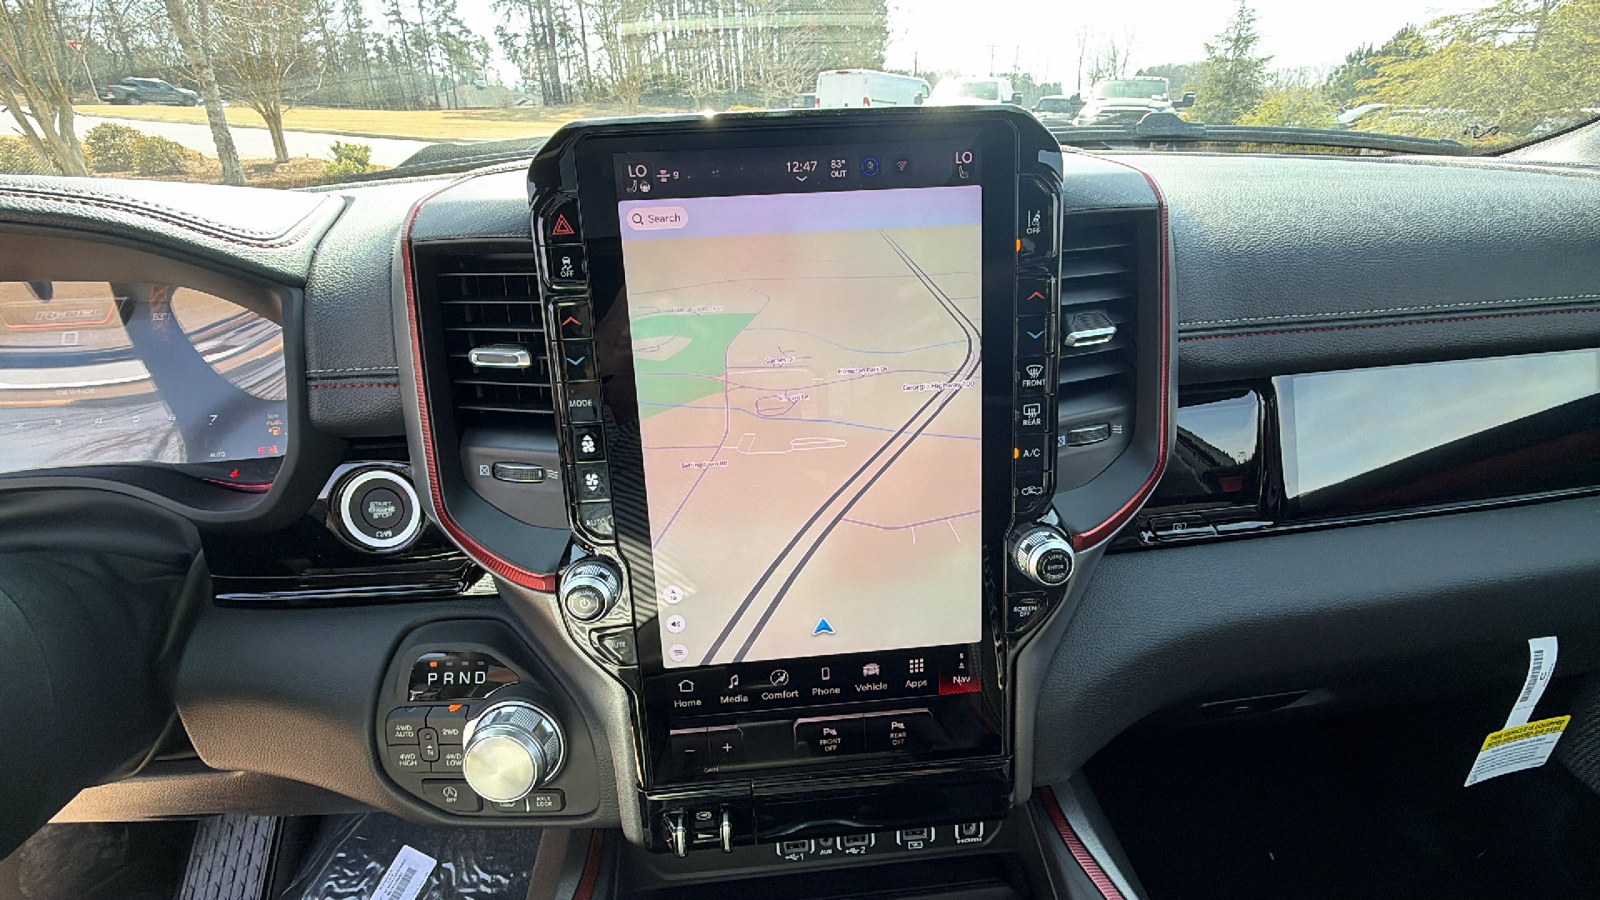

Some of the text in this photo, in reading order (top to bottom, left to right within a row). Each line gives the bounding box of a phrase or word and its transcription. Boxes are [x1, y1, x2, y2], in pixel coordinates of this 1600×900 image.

[955, 151, 972, 164] LO
[628, 164, 647, 178] LO
[786, 160, 818, 173] 12:47
[830, 169, 847, 178] OUT
[648, 213, 681, 224] Search
[1026, 227, 1041, 235] OFF
[560, 270, 575, 278] OFF
[866, 366, 880, 374] Park
[902, 384, 930, 393] Georgia
[931, 381, 961, 391] Highway
[1022, 378, 1046, 388] FRONT
[569, 399, 593, 408] MODE
[209, 414, 219, 424] 7
[1022, 417, 1042, 426] REAR
[1023, 448, 1041, 458] A/C
[368, 506, 396, 514] ENGINE
[586, 517, 607, 527] AUTO
[1013, 605, 1038, 613] SCREEN
[905, 679, 928, 689] Apps
[952, 675, 970, 685] Nav
[812, 686, 841, 696] Phone
[855, 682, 888, 692] Vehicle
[720, 694, 749, 704] Media
[761, 690, 799, 700] Comfort
[674, 699, 702, 708] Home
[820, 738, 842, 746] FRONT
[892, 738, 905, 746] OFF
[824, 744, 838, 752] OFF
